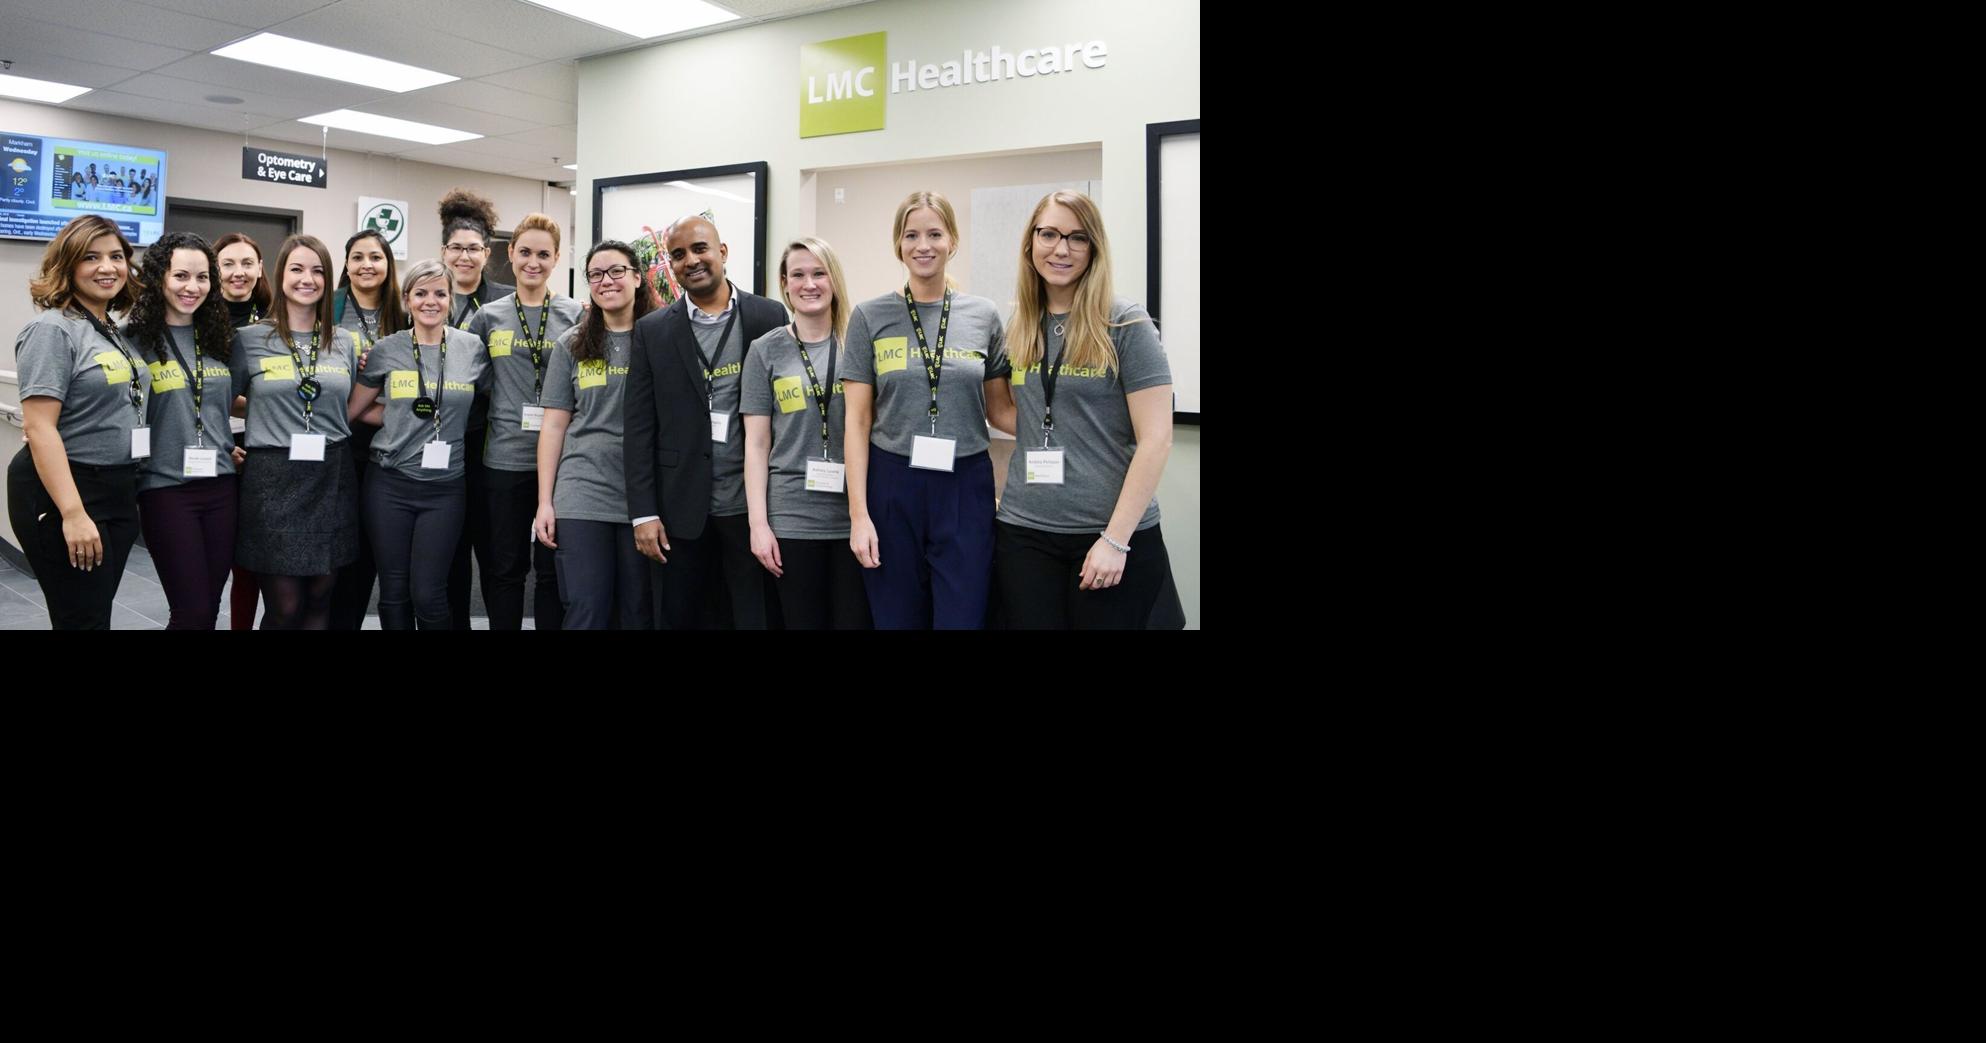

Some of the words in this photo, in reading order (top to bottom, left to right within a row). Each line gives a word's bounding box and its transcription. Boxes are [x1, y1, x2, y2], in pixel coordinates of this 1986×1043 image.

[808, 66, 875, 105] LMC
[891, 39, 1108, 95] Healthcare
[3, 146, 38, 156] Wednesday
[257, 152, 316, 173] Optometry
[257, 166, 266, 178] &
[268, 167, 287, 181] Eye
[288, 170, 312, 183] Care
[878, 348, 903, 362] LMC
[153, 368, 180, 382] LMC
[392, 379, 415, 389] LMC
[778, 386, 801, 402] LMC
